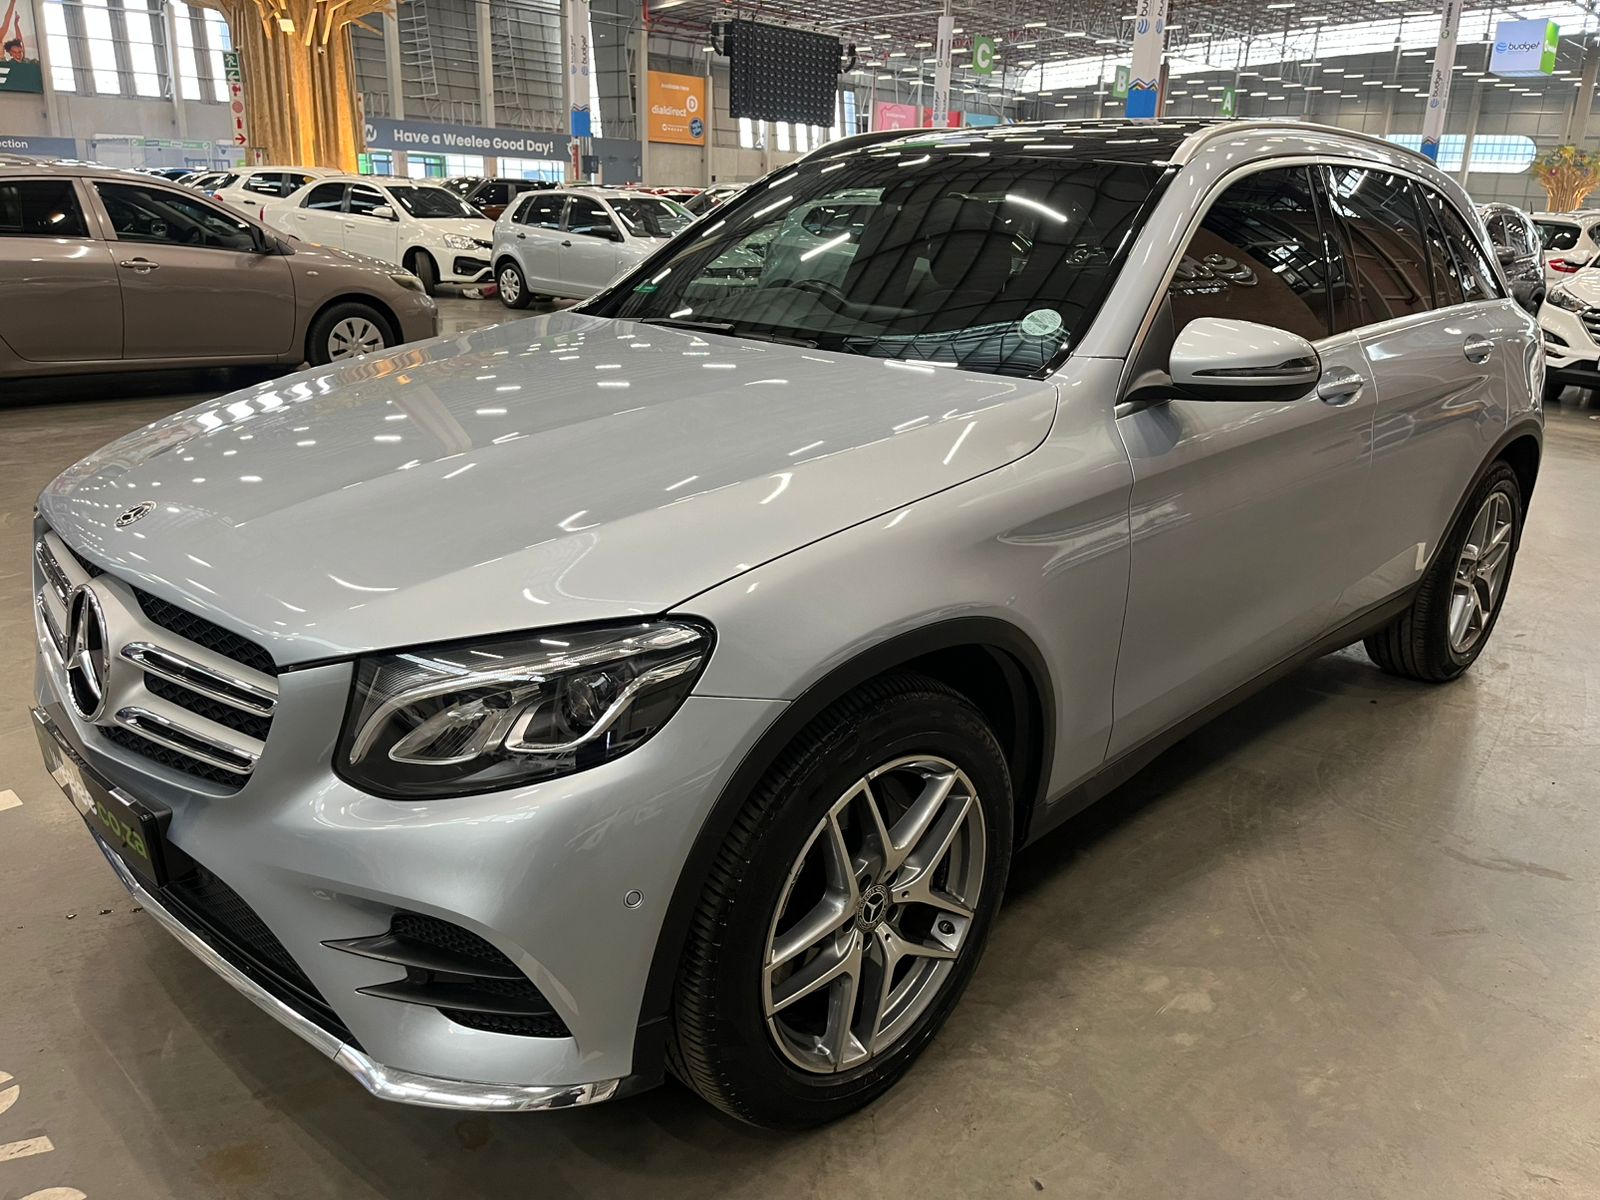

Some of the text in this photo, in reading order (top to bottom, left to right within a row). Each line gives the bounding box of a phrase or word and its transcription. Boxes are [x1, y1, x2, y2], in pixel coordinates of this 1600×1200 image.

[976, 43, 991, 68] C
[1507, 40, 1541, 53] budget
[1116, 70, 1127, 92] B
[651, 105, 687, 117] dialdirect
[1222, 91, 1232, 111] A
[393, 129, 554, 156] Have a Weelee Good Day!
